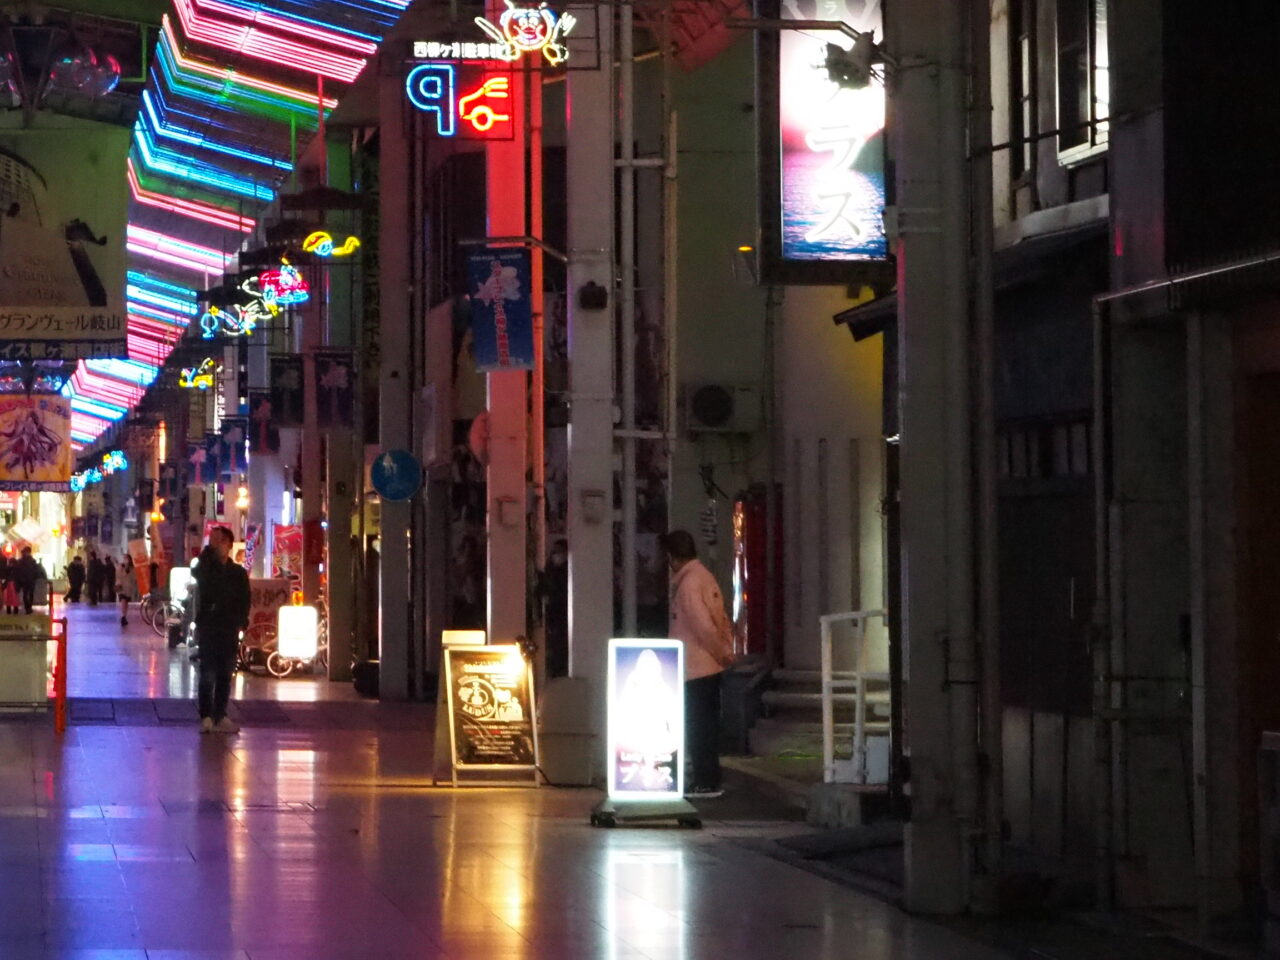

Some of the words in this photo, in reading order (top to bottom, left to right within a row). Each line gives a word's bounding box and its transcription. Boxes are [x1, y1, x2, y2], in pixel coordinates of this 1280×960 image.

[0, 314, 121, 331] グランヴェール岐山
